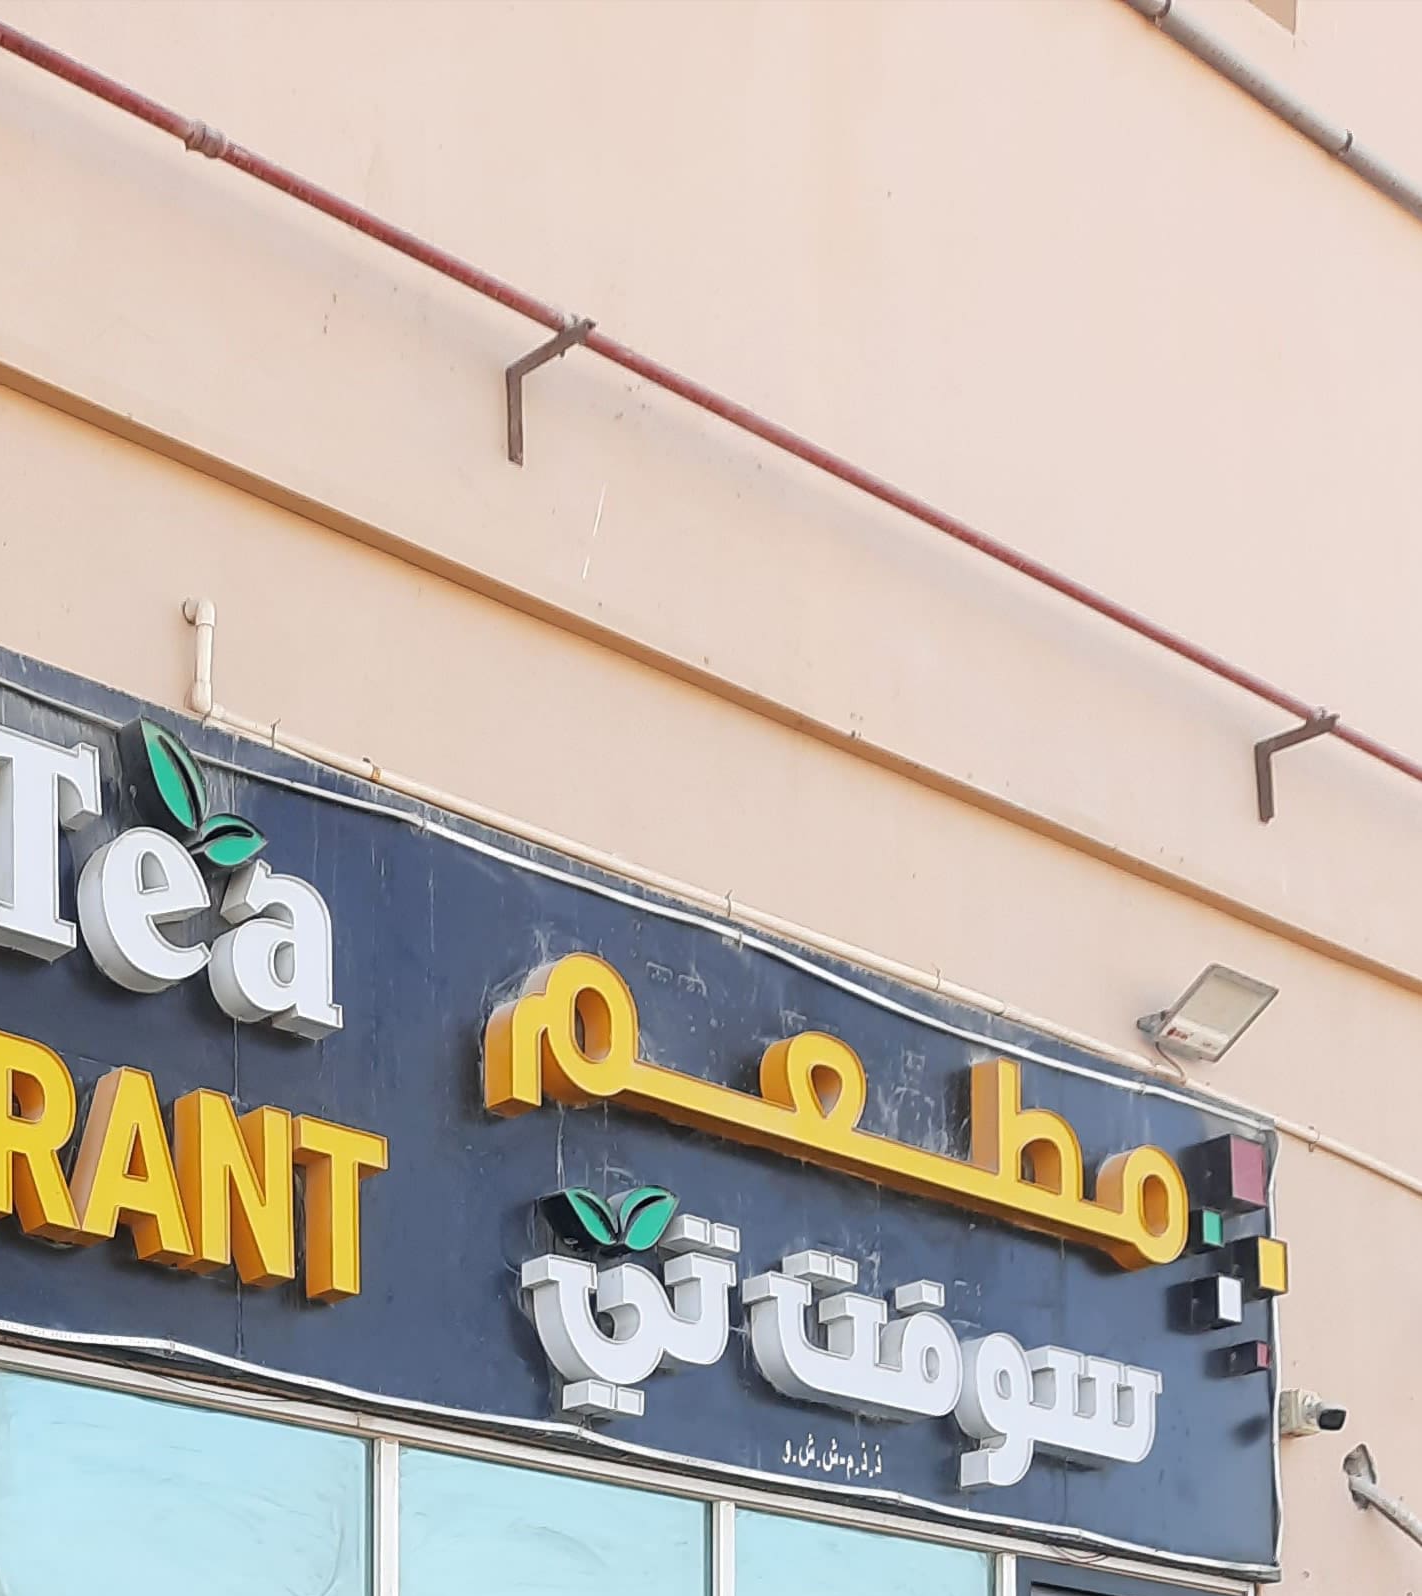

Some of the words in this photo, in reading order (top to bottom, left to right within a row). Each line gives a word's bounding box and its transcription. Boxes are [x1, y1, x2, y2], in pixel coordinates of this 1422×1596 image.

[483, 952, 1189, 1270] مطعم
[522, 1214, 741, 1417] تي
[743, 1250, 1162, 1489] سوفت
